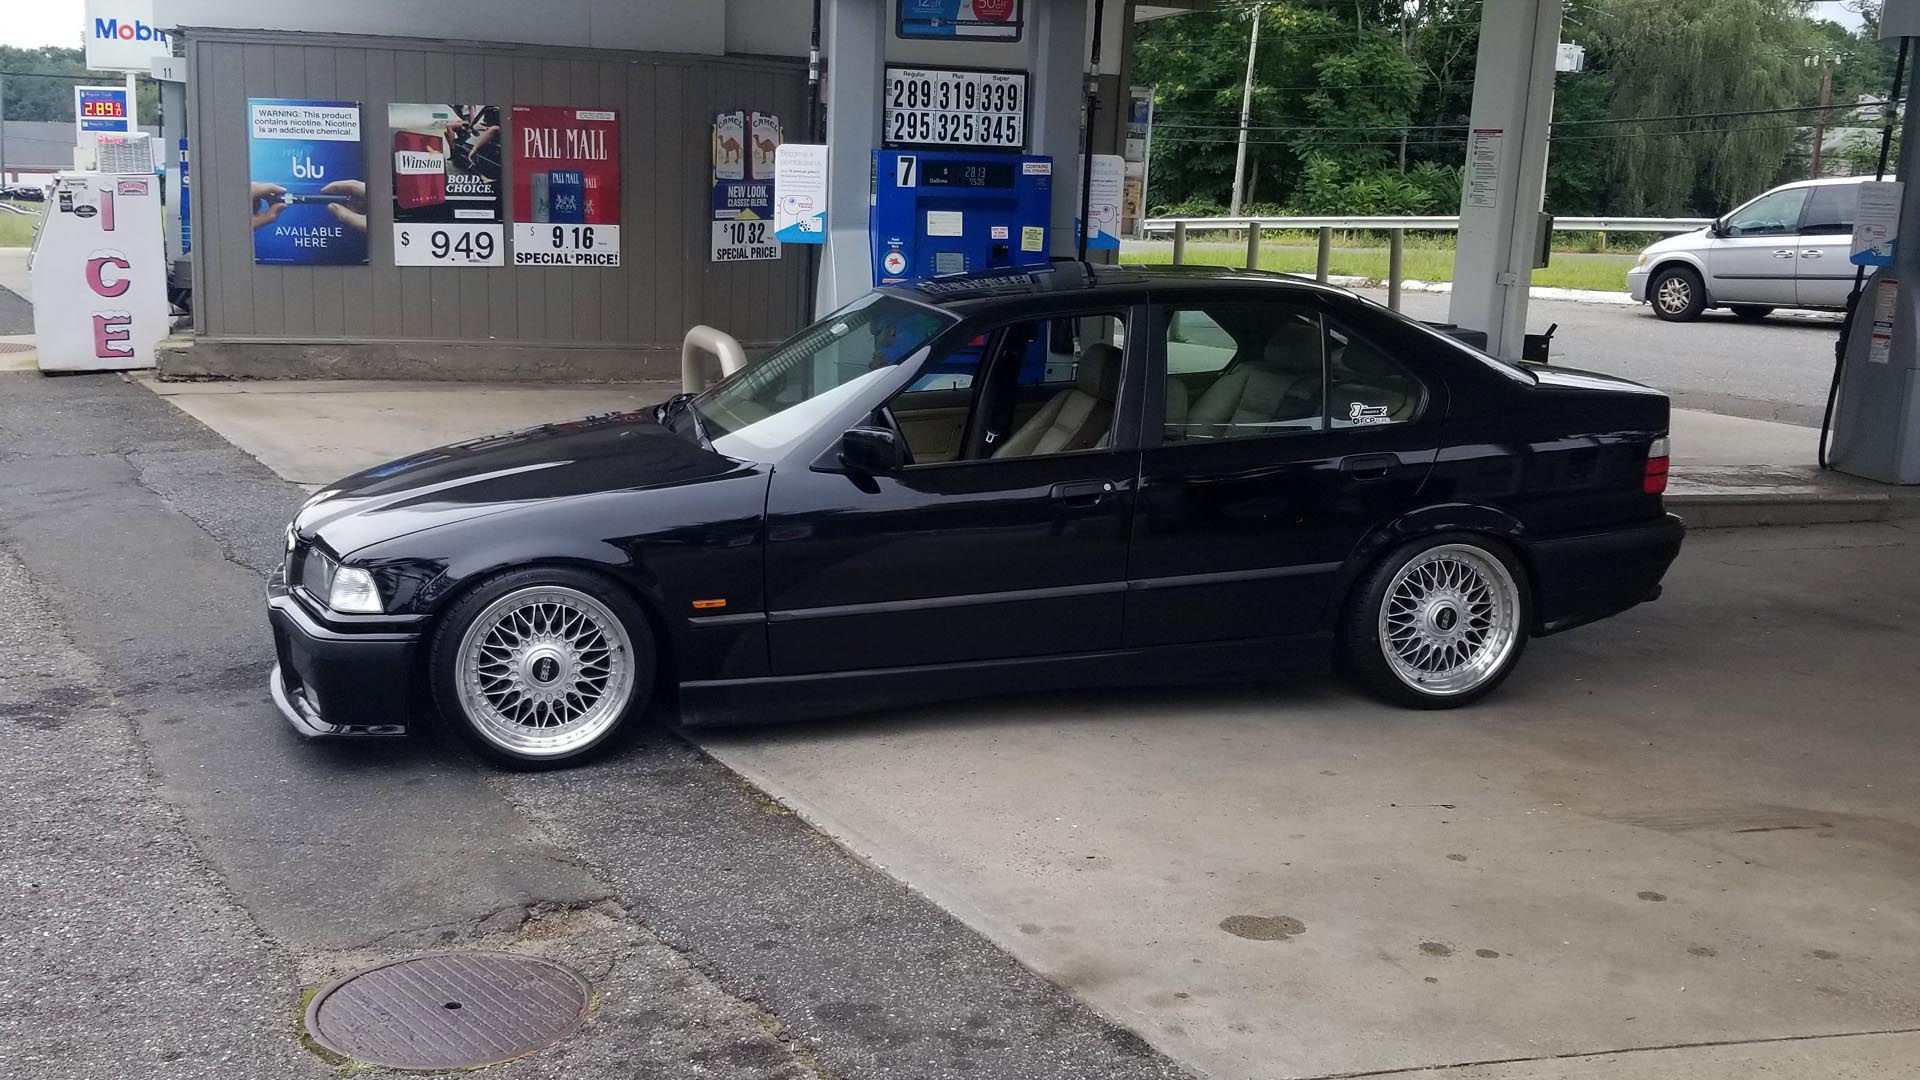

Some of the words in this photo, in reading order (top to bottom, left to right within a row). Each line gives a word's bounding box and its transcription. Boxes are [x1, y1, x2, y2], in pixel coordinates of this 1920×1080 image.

[894, 80, 930, 108] 289
[940, 82, 975, 110] 319
[982, 84, 1018, 112] 339
[259, 110, 301, 118] WARNING:
[322, 112, 352, 120] product
[718, 116, 742, 128] CAMEL
[316, 128, 352, 136] chemical.
[753, 118, 778, 132] CAMEL
[894, 112, 930, 140] 295
[938, 114, 973, 142] 325
[980, 116, 1016, 144] 345
[524, 128, 561, 158] PALL
[566, 128, 608, 160] MALL
[292, 156, 324, 178] blu
[402, 154, 442, 168] Winston
[552, 173, 564, 184] PALL
[566, 173, 580, 184] MALL
[900, 157, 914, 186] 7
[448, 175, 482, 184] BOLD.
[446, 184, 494, 194] CHOICE.
[728, 186, 746, 198] NEW
[747, 186, 768, 198] LOOK.
[728, 198, 750, 207] CLASSIC
[275, 226, 342, 237] AVAILABLE
[552, 226, 594, 249] 9.16
[730, 222, 765, 245] 10.32
[294, 237, 328, 248] HERE
[401, 231, 410, 248] $
[431, 230, 494, 261] 9.49
[516, 252, 572, 264] SPECIAL
[576, 253, 618, 265] PRICE!
[716, 247, 749, 260] SPECIAL
[751, 246, 777, 259] PRICE!
